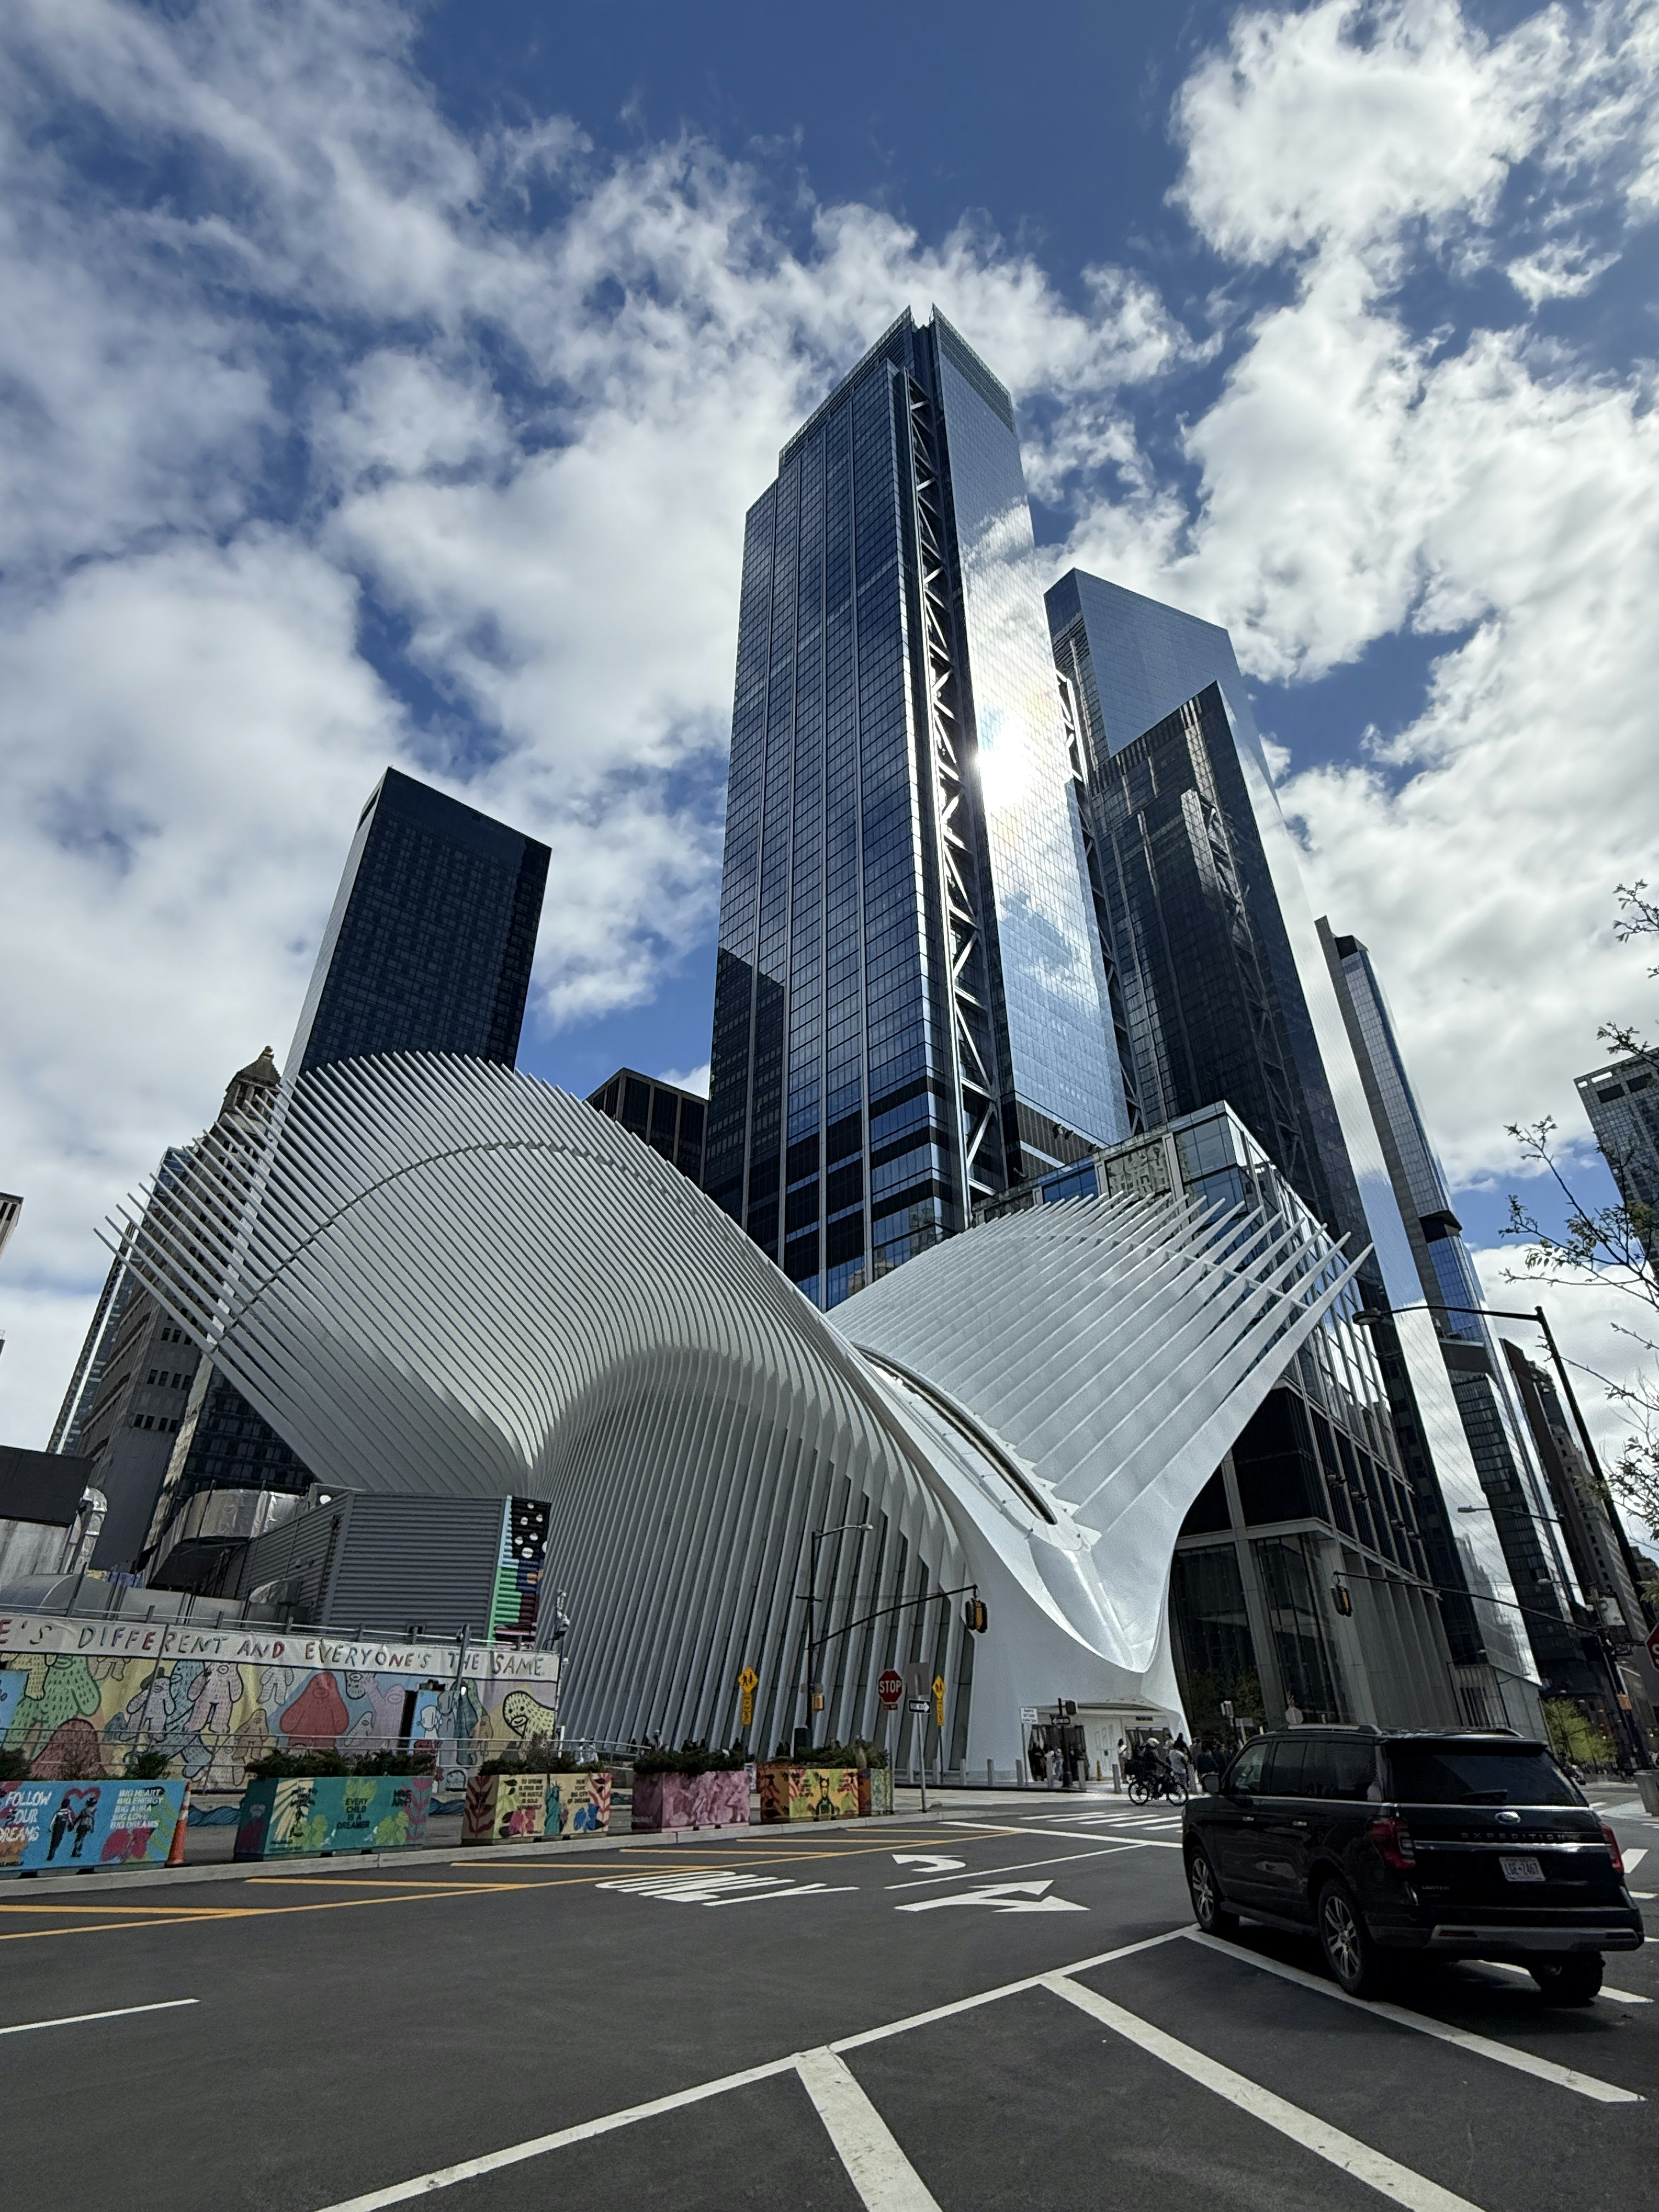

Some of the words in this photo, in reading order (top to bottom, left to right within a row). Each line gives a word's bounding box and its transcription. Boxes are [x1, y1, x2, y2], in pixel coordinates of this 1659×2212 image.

[78, 1625, 228, 1654] DIFFERENT
[236, 1639, 285, 1659] AND
[305, 1640, 432, 1669] EVERYONE'S
[448, 1650, 479, 1671] THE
[491, 1654, 544, 1676] SAME
[879, 1680, 901, 1694] STOP
[119, 1789, 134, 1797] BIG
[134, 1788, 162, 1797] HEART
[5, 1791, 53, 1807] FOLLOW
[116, 1797, 132, 1805] BIG
[132, 1796, 164, 1805] ENERGY
[345, 1797, 369, 1806] EVERY
[114, 1804, 129, 1813] BIG
[130, 1804, 152, 1813] AURA
[112, 1813, 127, 1821] BIG
[110, 1820, 125, 1829] BIG
[126, 1820, 159, 1829] DREAMS
[336, 1820, 370, 1830] DREAMER
